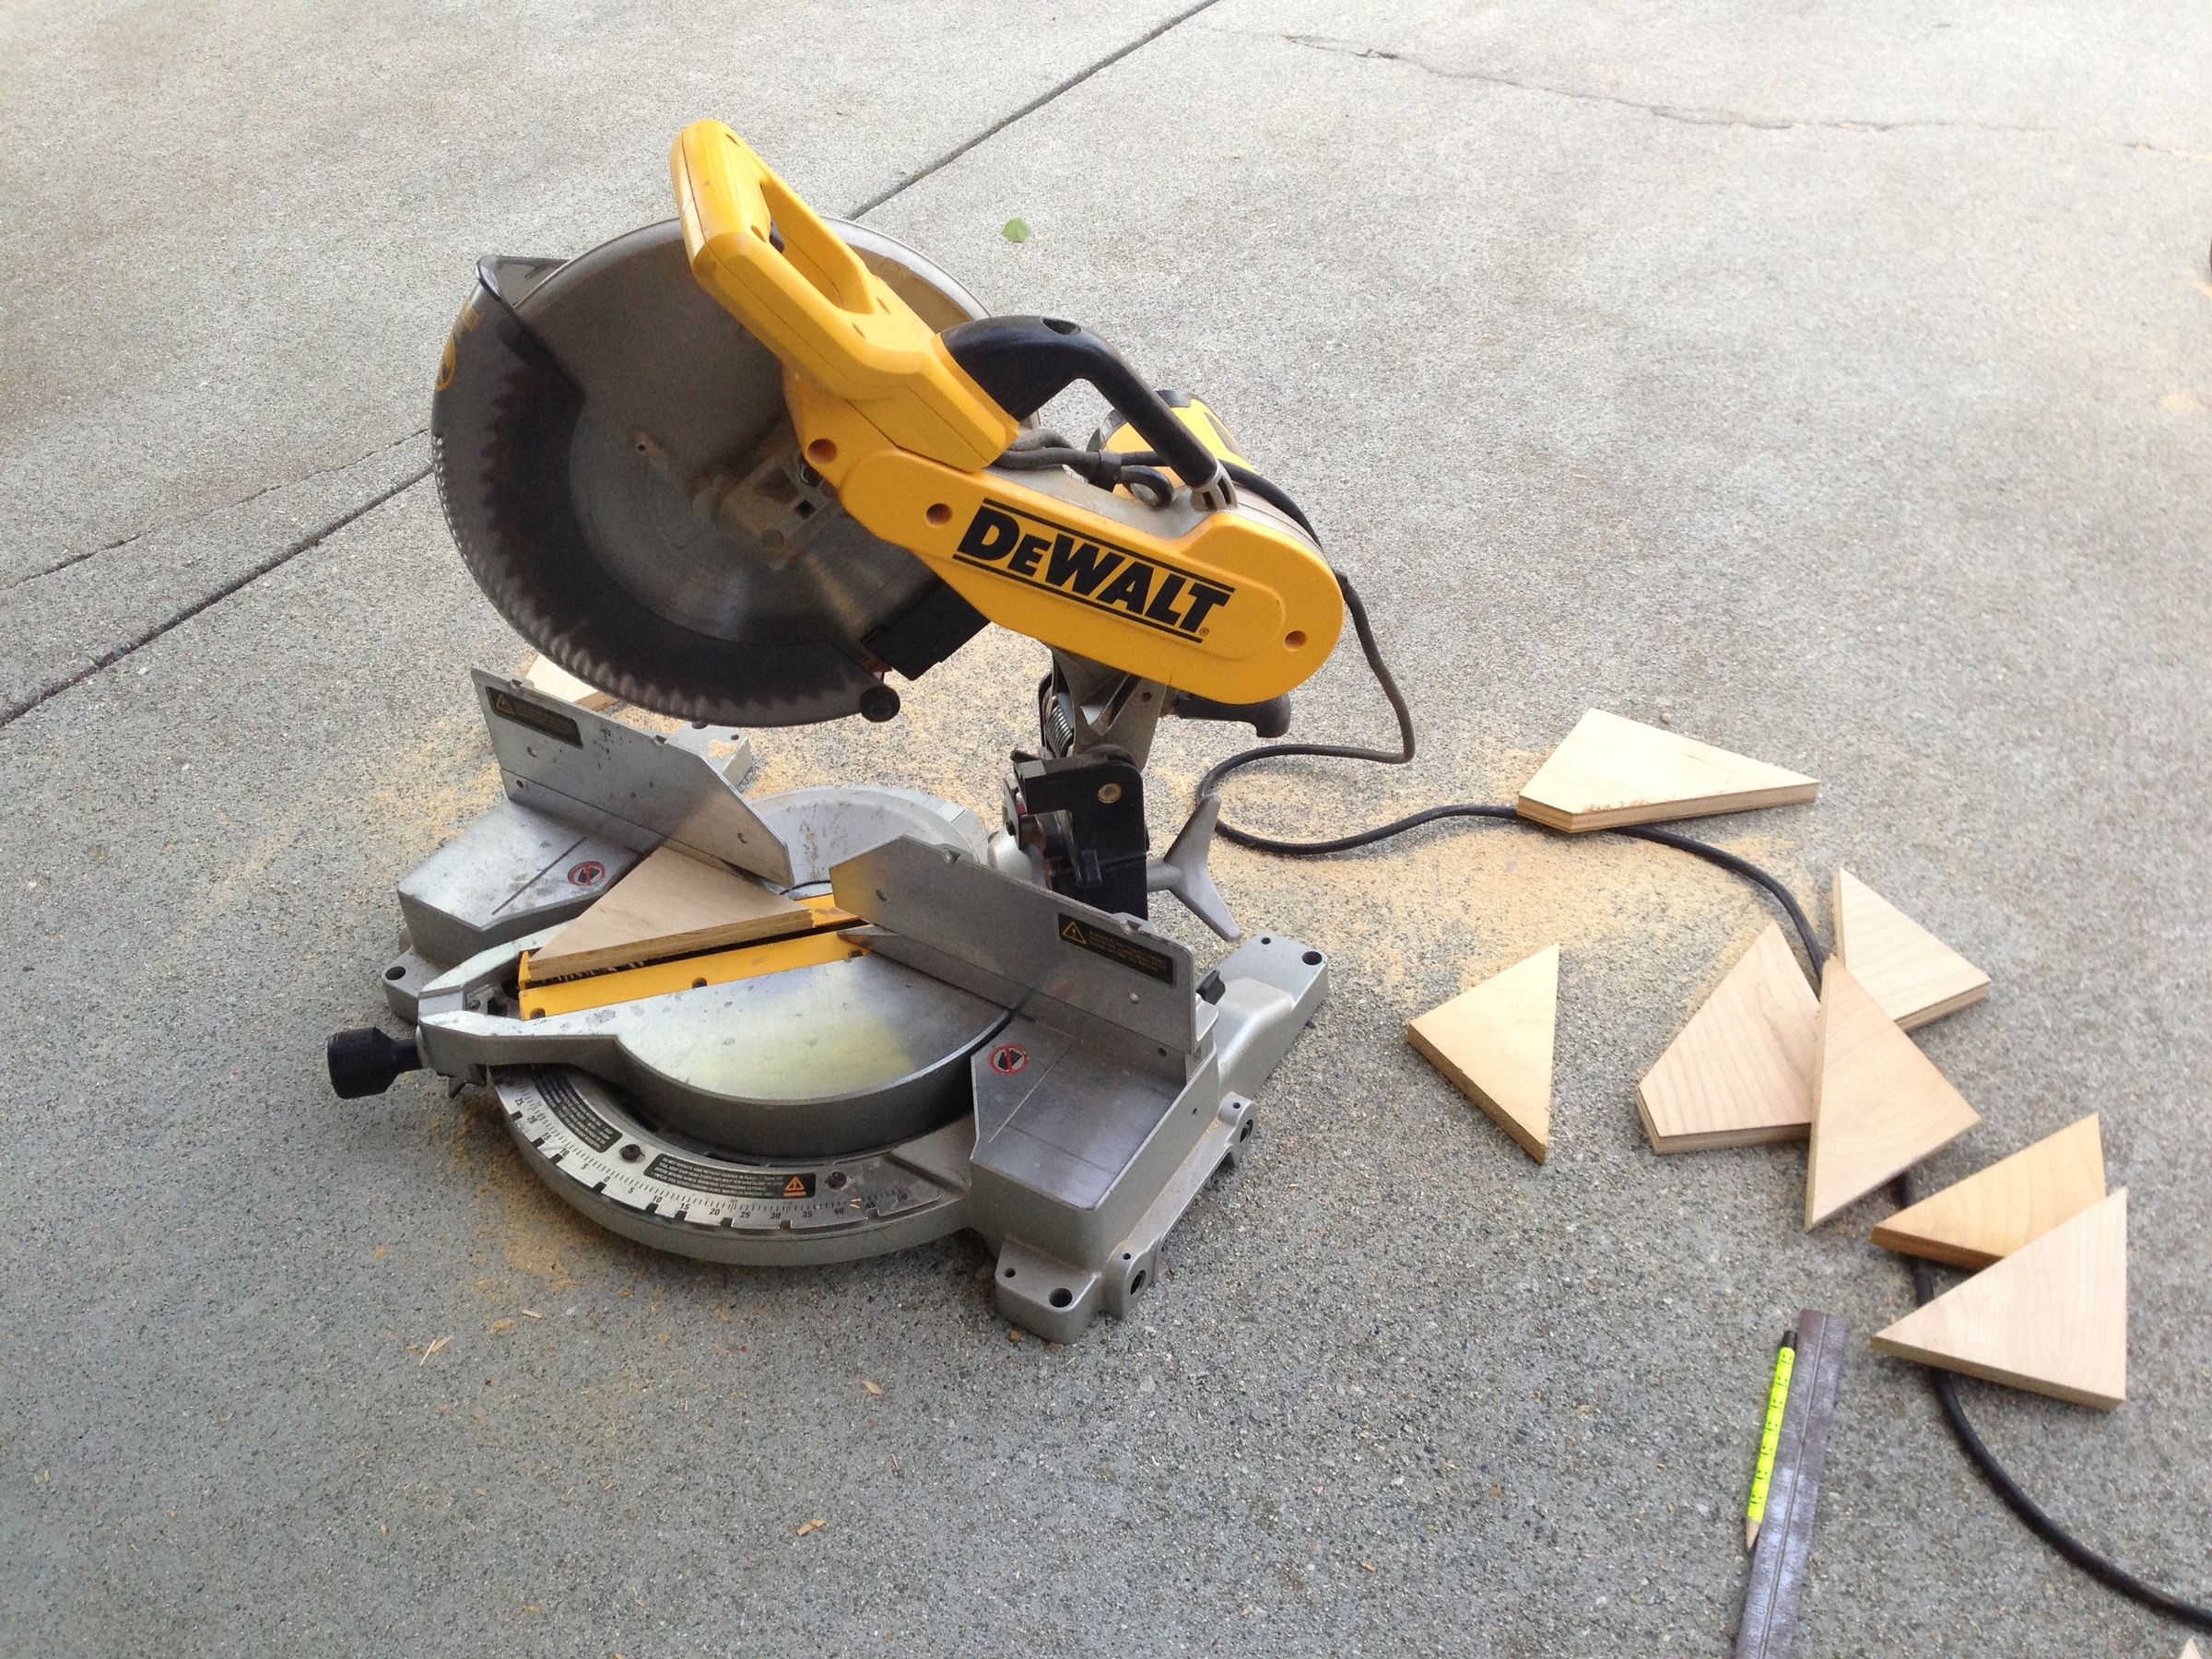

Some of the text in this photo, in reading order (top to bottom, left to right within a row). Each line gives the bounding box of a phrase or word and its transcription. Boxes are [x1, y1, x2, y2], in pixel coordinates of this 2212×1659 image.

[515, 1098, 524, 1106] 25
[526, 1115, 537, 1124] 20
[541, 1132, 552, 1141] 15
[559, 1147, 570, 1157] 10
[680, 1203, 689, 1211] 15
